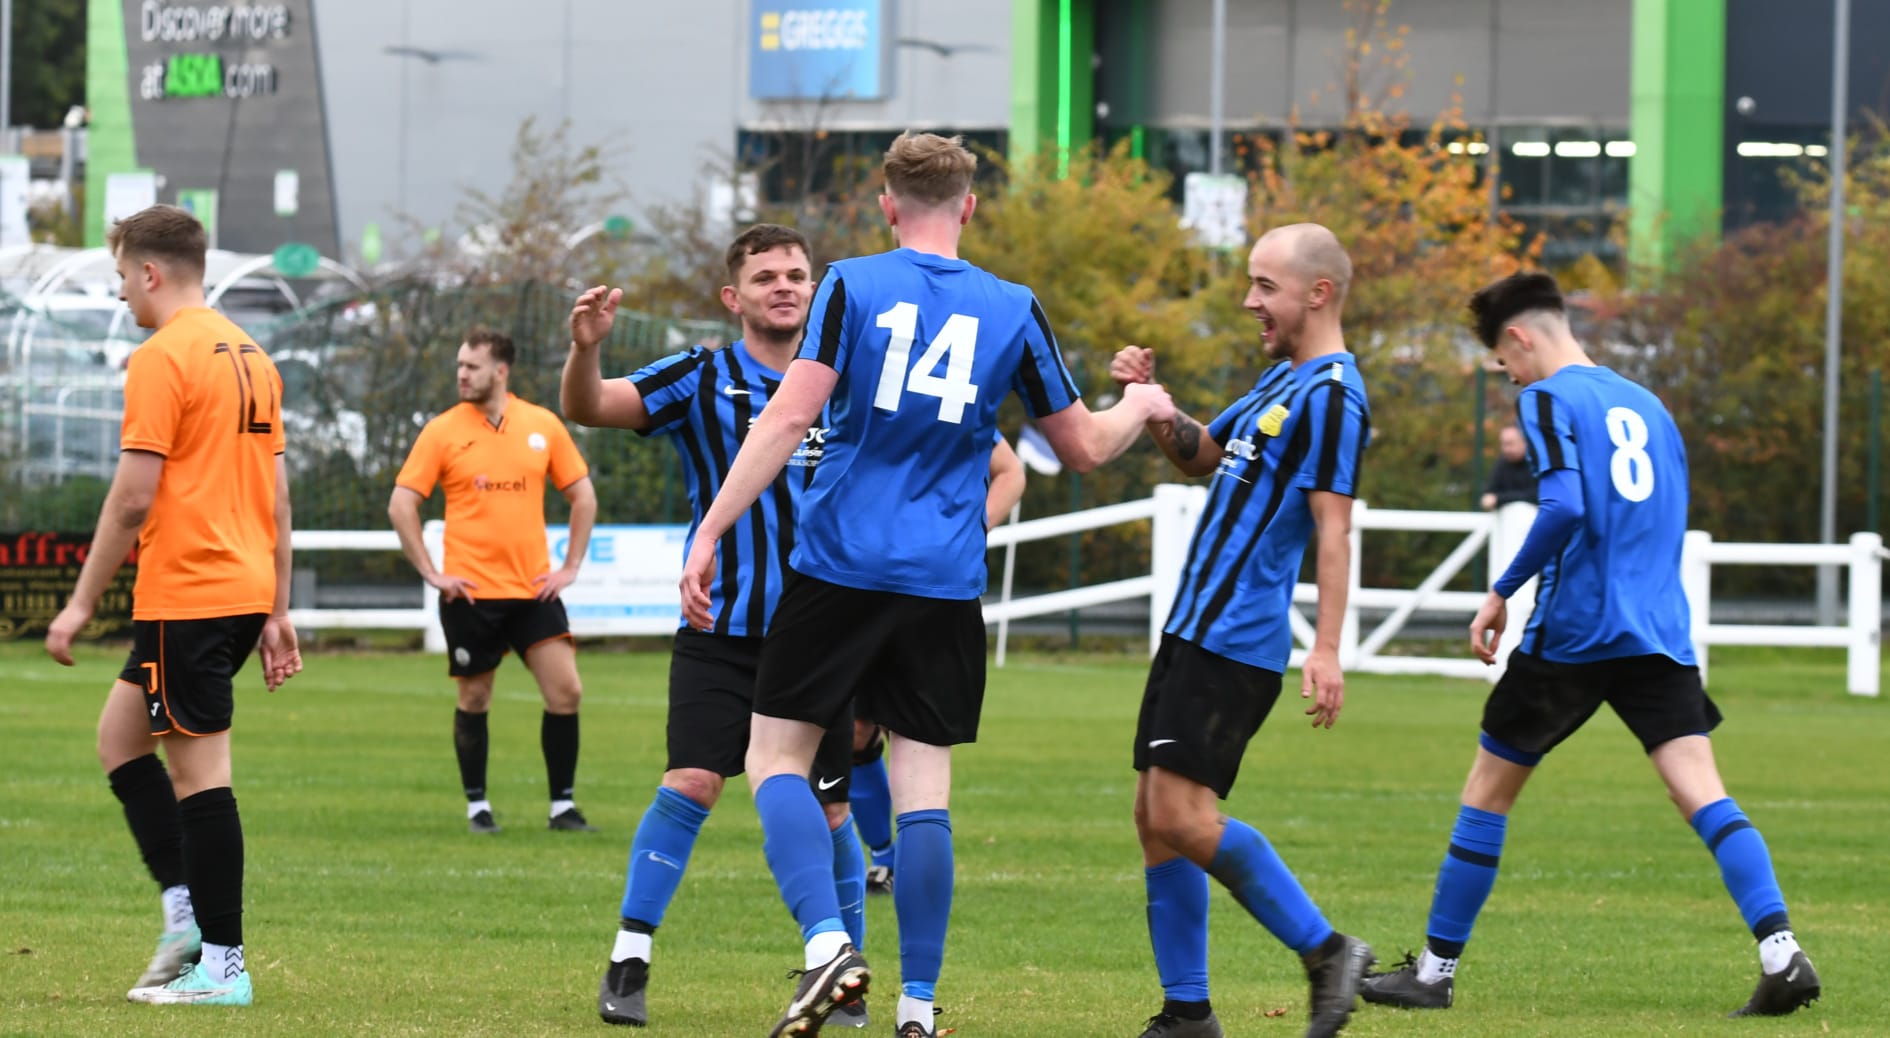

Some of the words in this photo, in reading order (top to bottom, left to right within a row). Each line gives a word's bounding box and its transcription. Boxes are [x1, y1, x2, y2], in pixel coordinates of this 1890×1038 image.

[141, 0, 231, 41] Discover
[230, 4, 289, 40] more
[781, 9, 867, 50] GREGGS
[140, 59, 165, 99] at
[873, 301, 979, 425] 14
[214, 342, 275, 434] 10
[1605, 406, 1655, 503] 8
[484, 475, 526, 491] excel
